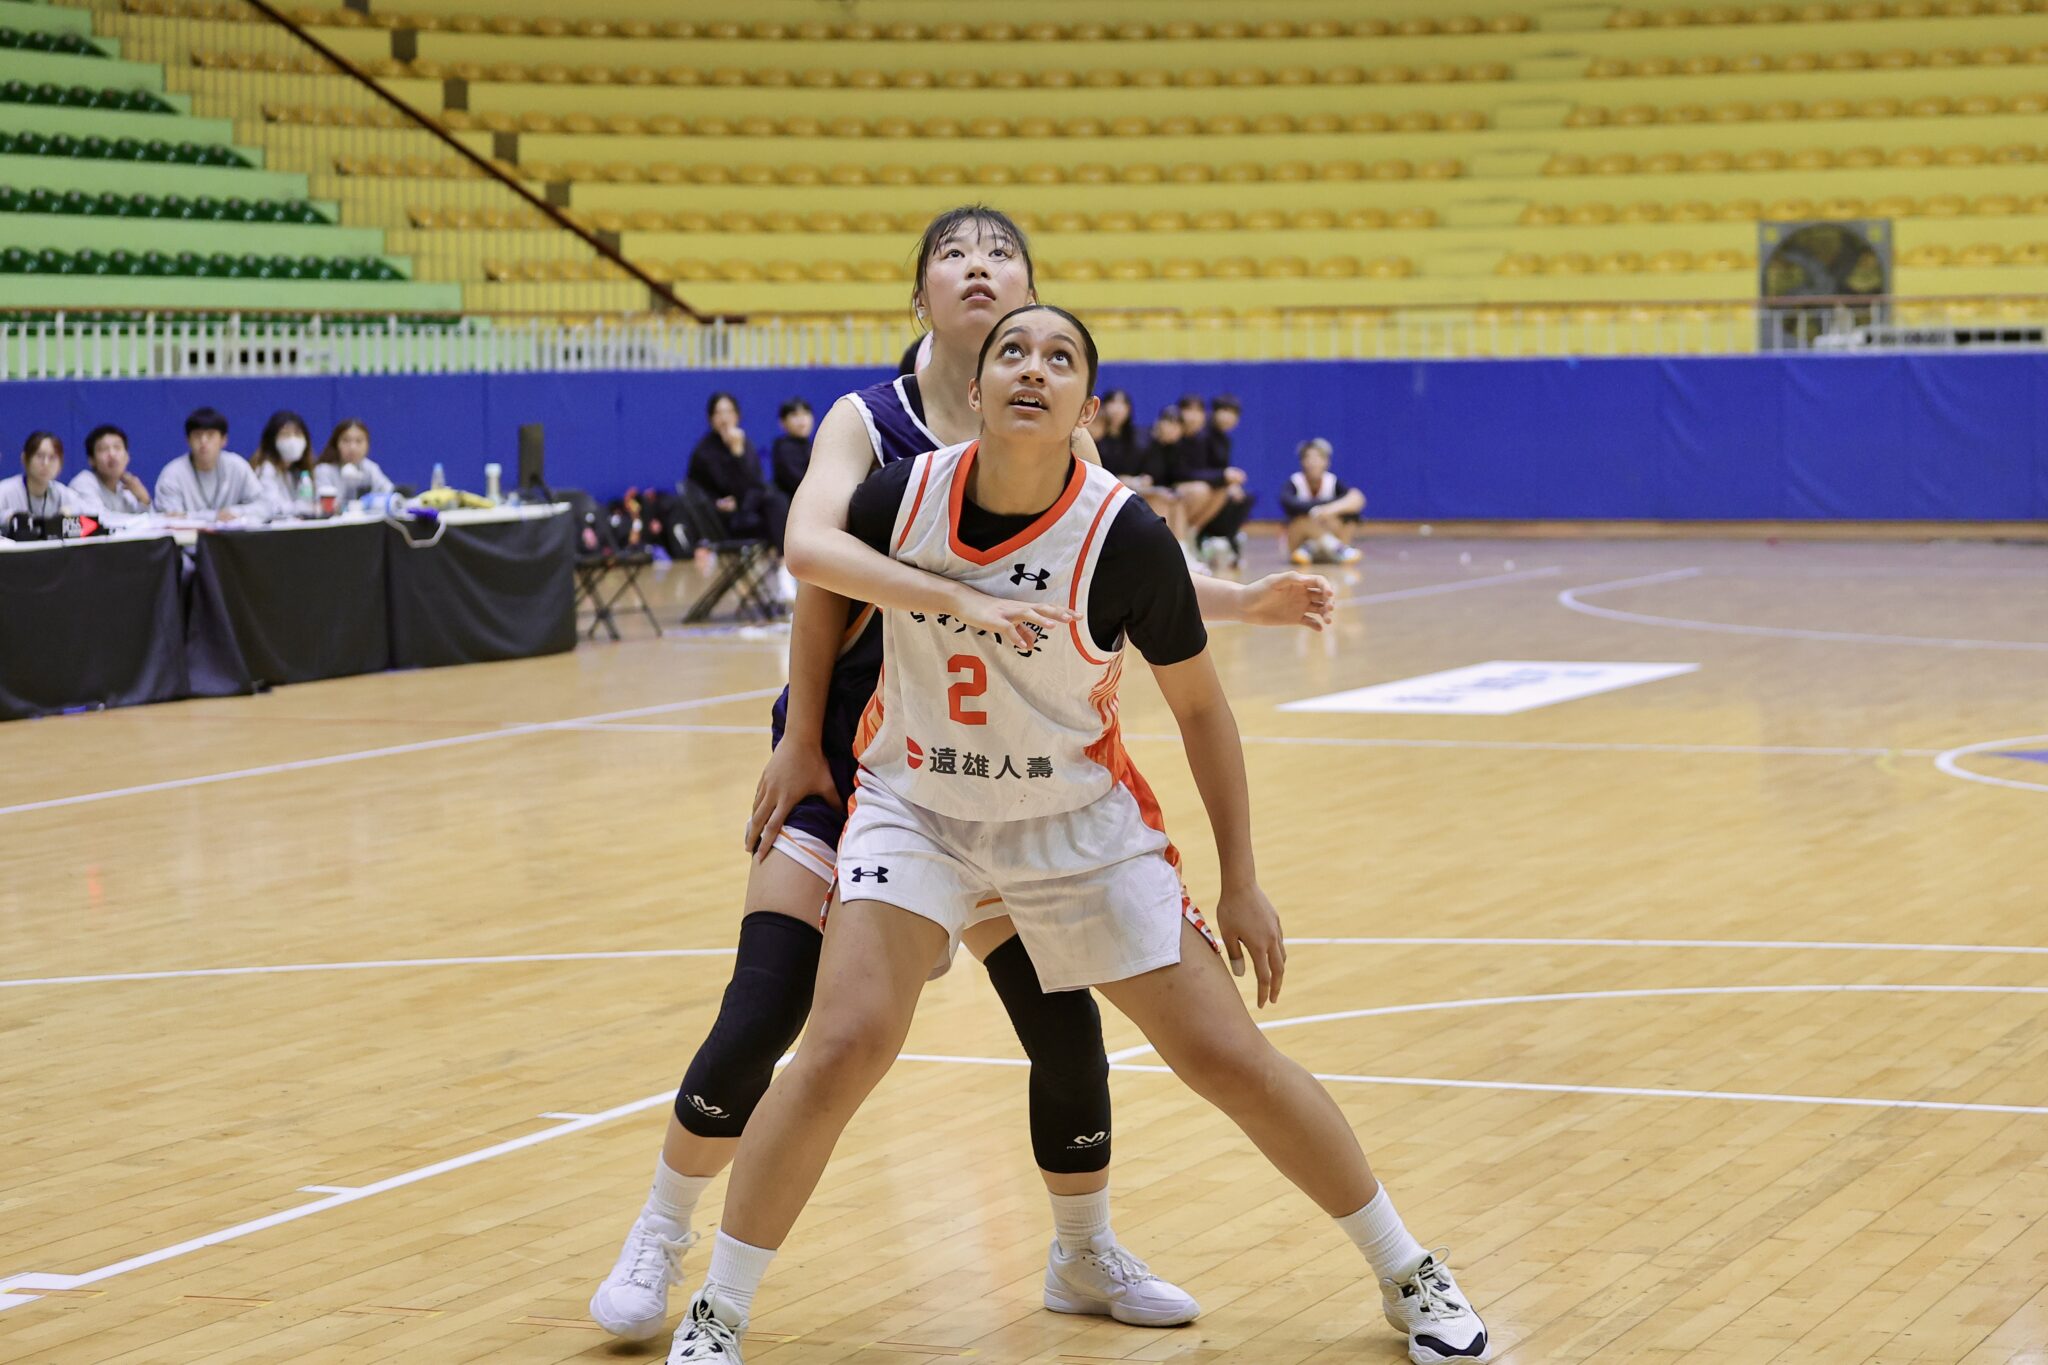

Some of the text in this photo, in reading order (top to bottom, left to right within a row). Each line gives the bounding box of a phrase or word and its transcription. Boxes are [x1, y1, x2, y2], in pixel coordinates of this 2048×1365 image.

[947, 653, 987, 725] 2
[929, 745, 1054, 779] 遠雄人壽
